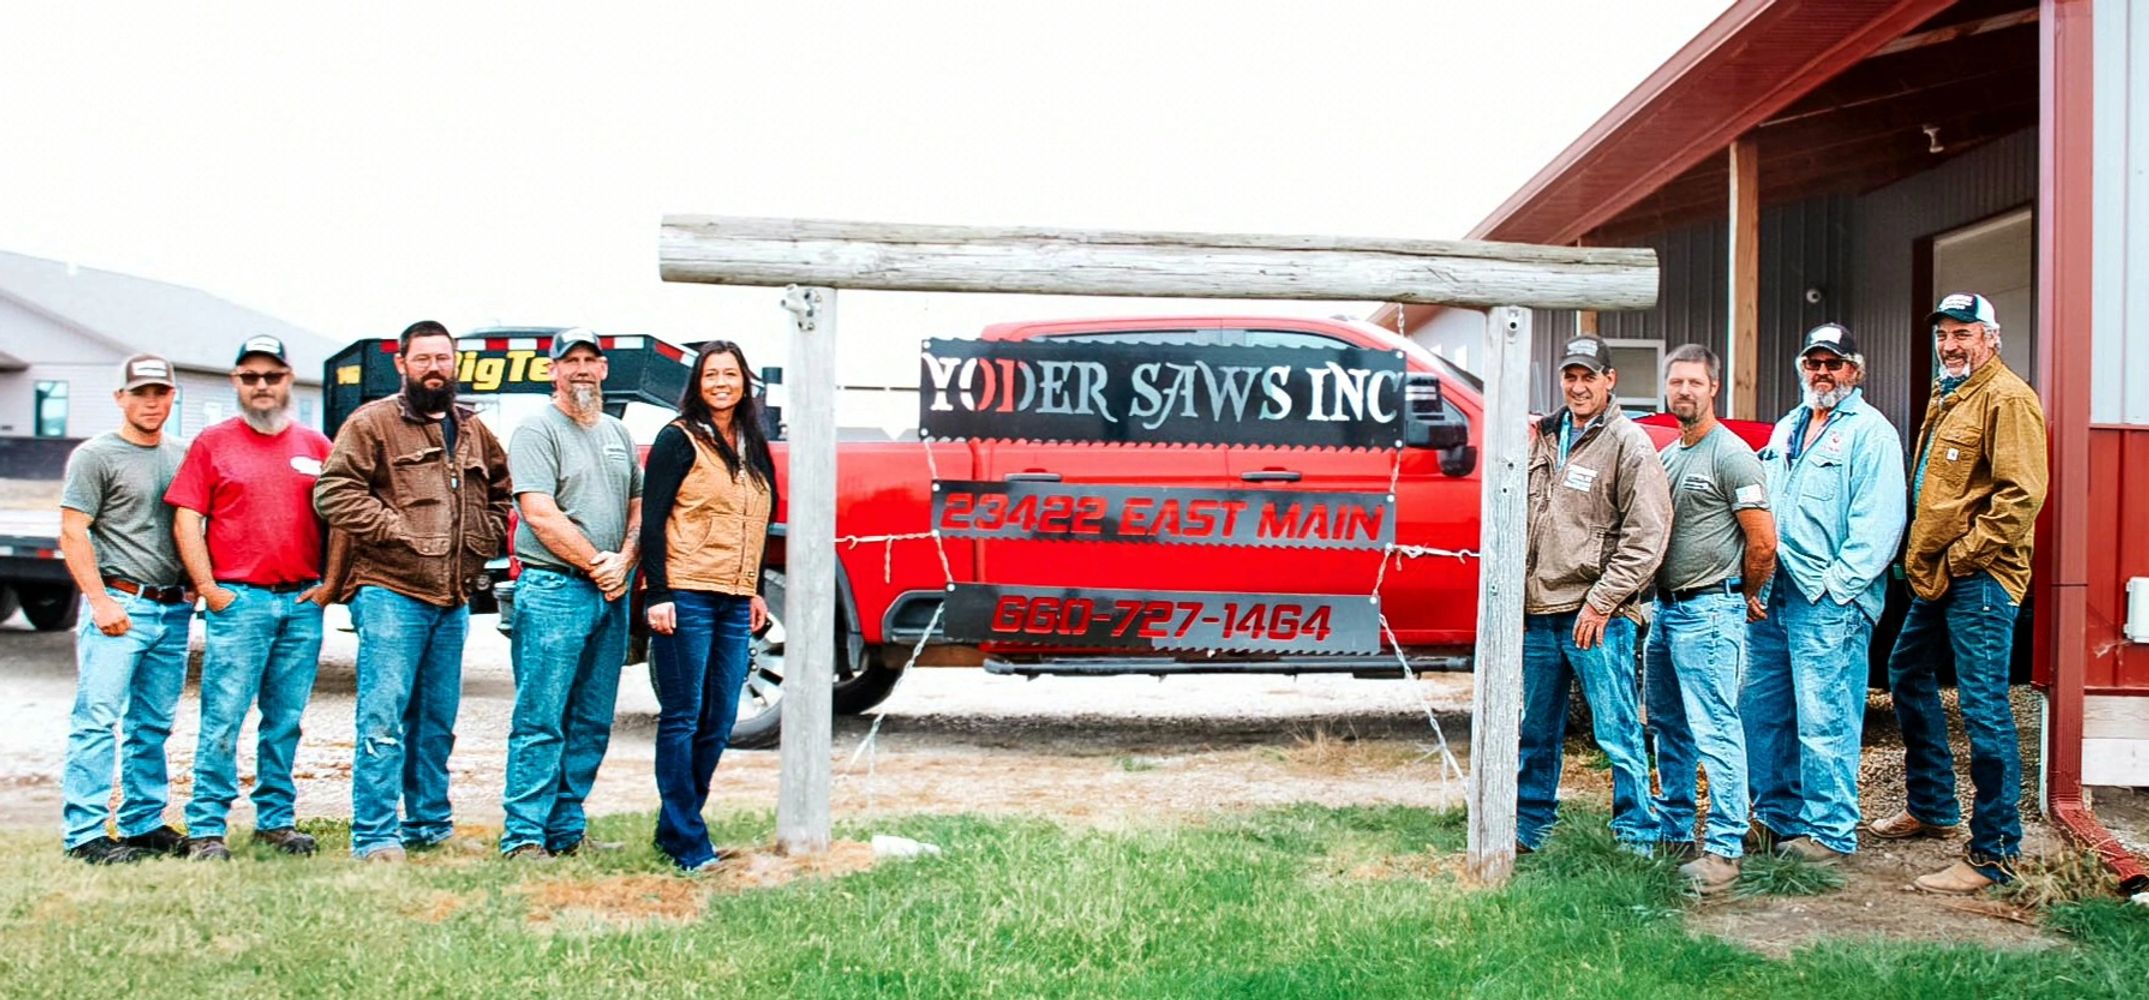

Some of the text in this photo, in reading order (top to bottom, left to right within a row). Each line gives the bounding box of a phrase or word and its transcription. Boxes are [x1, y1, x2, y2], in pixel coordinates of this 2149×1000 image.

[922, 352, 1404, 430] YODER SAWS INC
[940, 493, 1386, 542] 23422 EAST MAIN
[991, 594, 1332, 642] 660-727-1464
